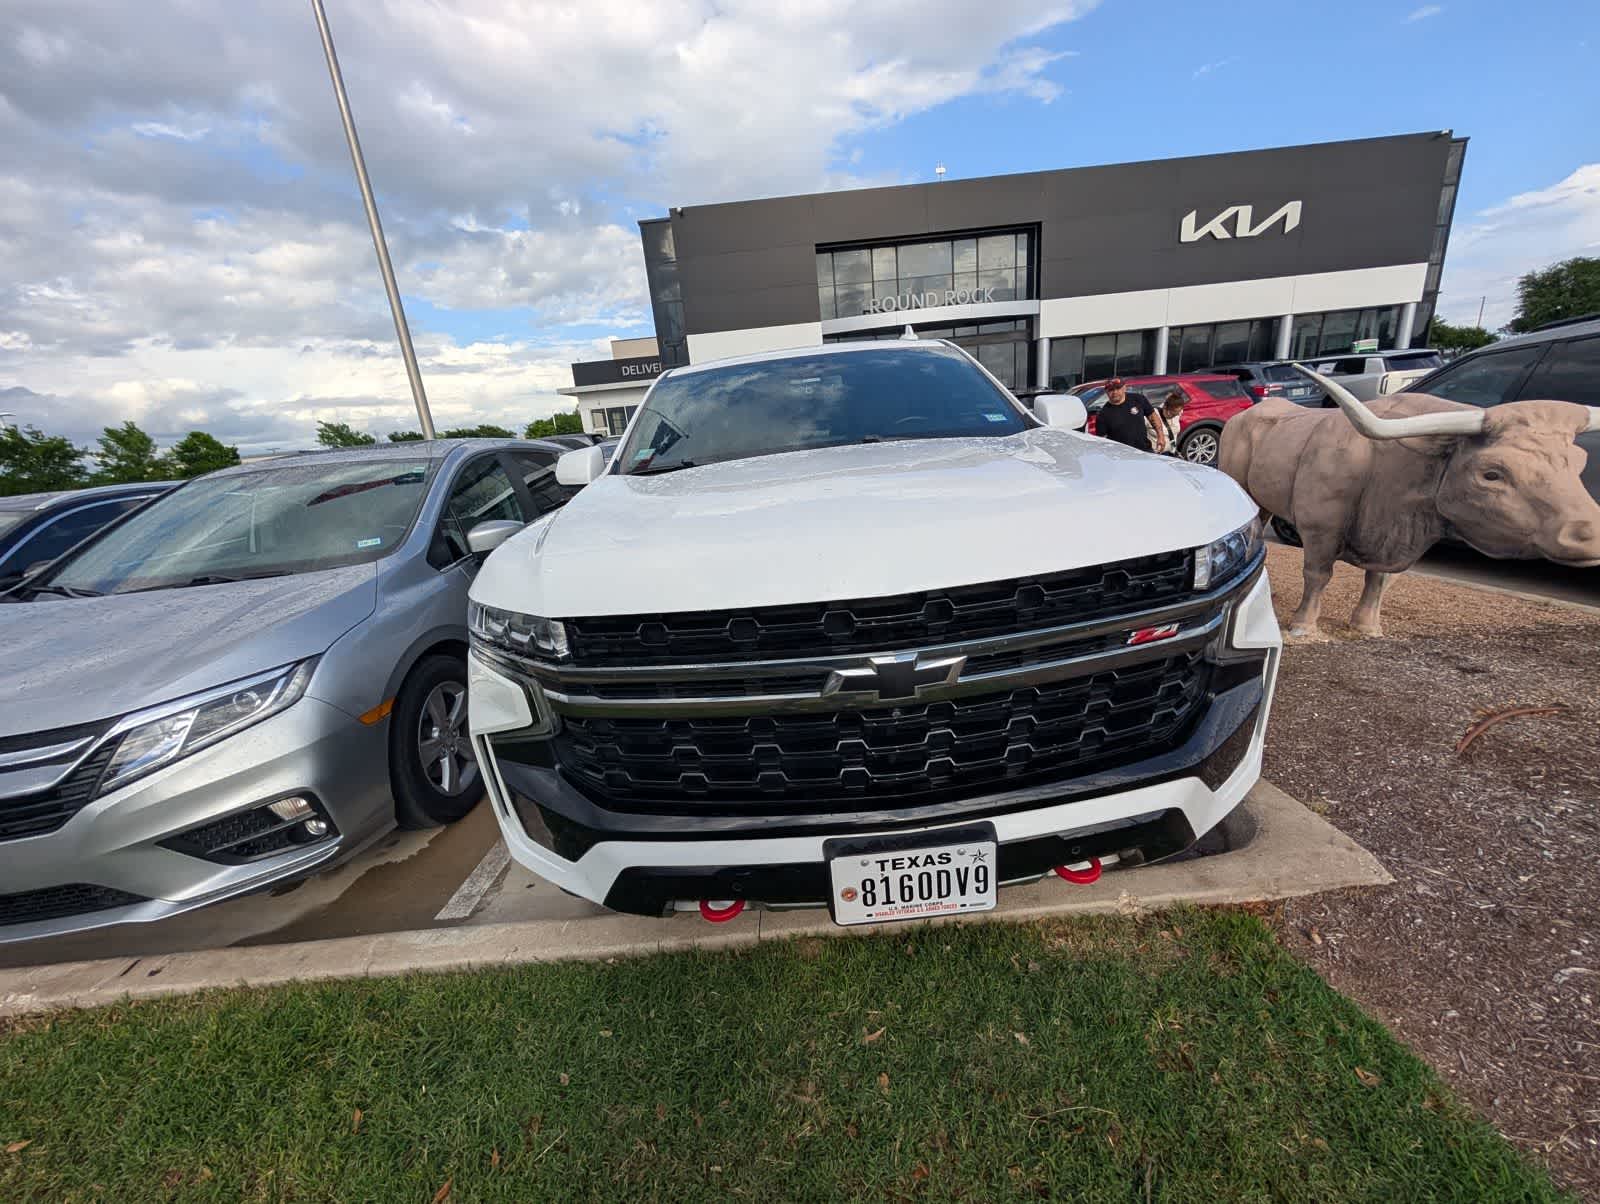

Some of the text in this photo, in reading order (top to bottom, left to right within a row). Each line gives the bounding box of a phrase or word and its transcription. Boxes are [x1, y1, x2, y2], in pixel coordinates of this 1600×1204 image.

[1180, 200, 1303, 242] KIA
[869, 287, 994, 314] ROUND ROCK
[621, 362, 662, 376] DELIVE
[875, 852, 952, 872] TEXAS
[861, 865, 989, 907] 8160DV9
